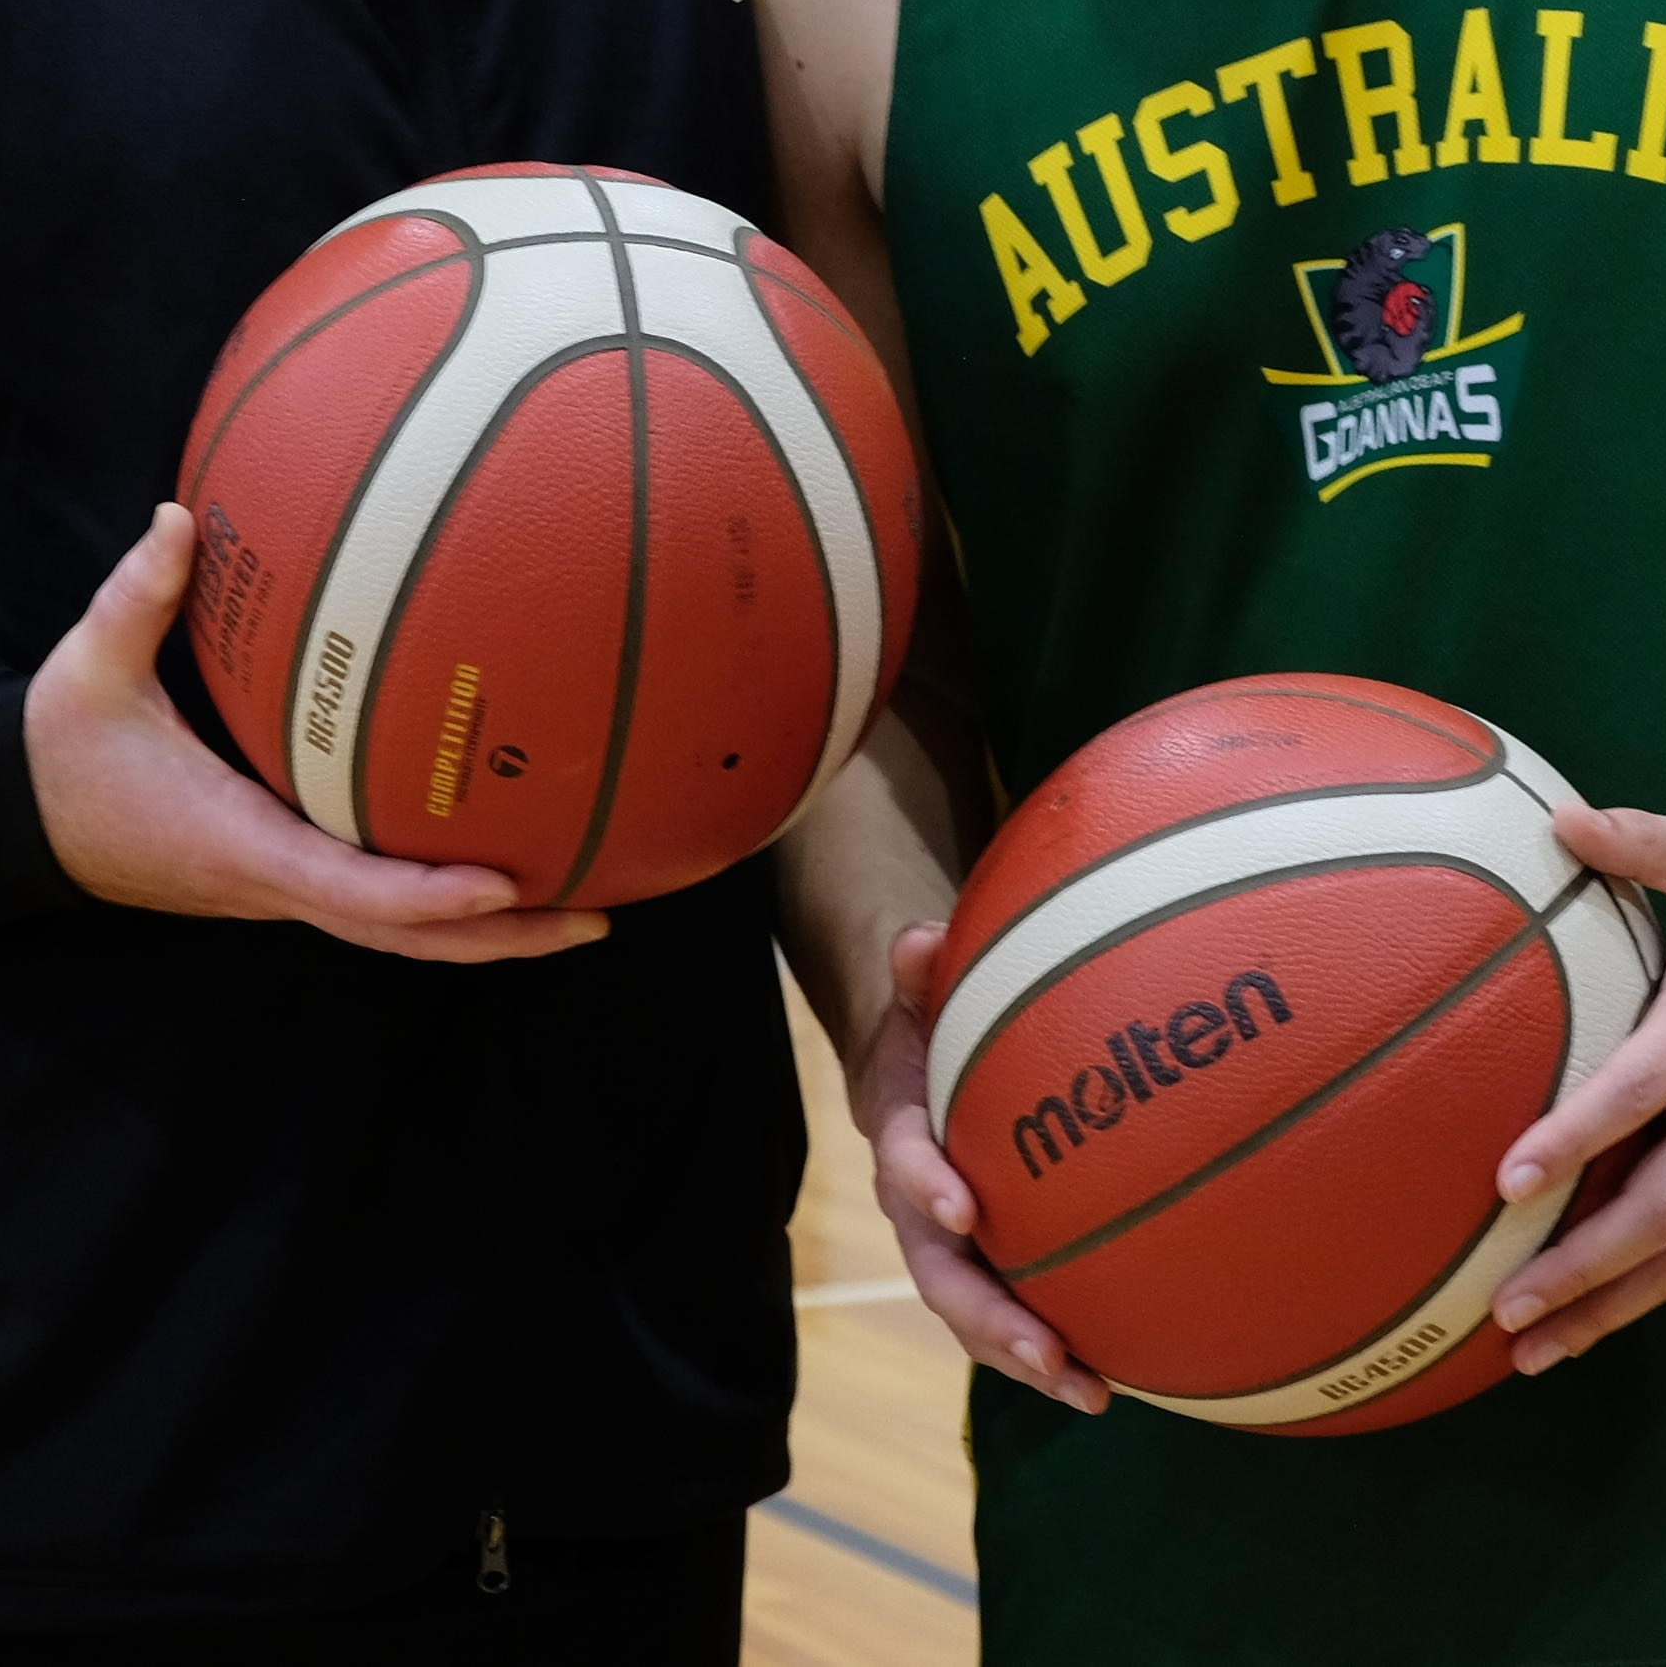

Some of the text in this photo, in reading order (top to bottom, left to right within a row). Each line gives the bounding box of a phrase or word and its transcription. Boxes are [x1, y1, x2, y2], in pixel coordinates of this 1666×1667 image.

[1300, 363, 1502, 481] GOANNAS
[305, 630, 355, 755] BG4500
[426, 662, 480, 818] COMPETITION
[1013, 970, 1293, 1180] molten
[1317, 1322, 1447, 1401] BG4500
